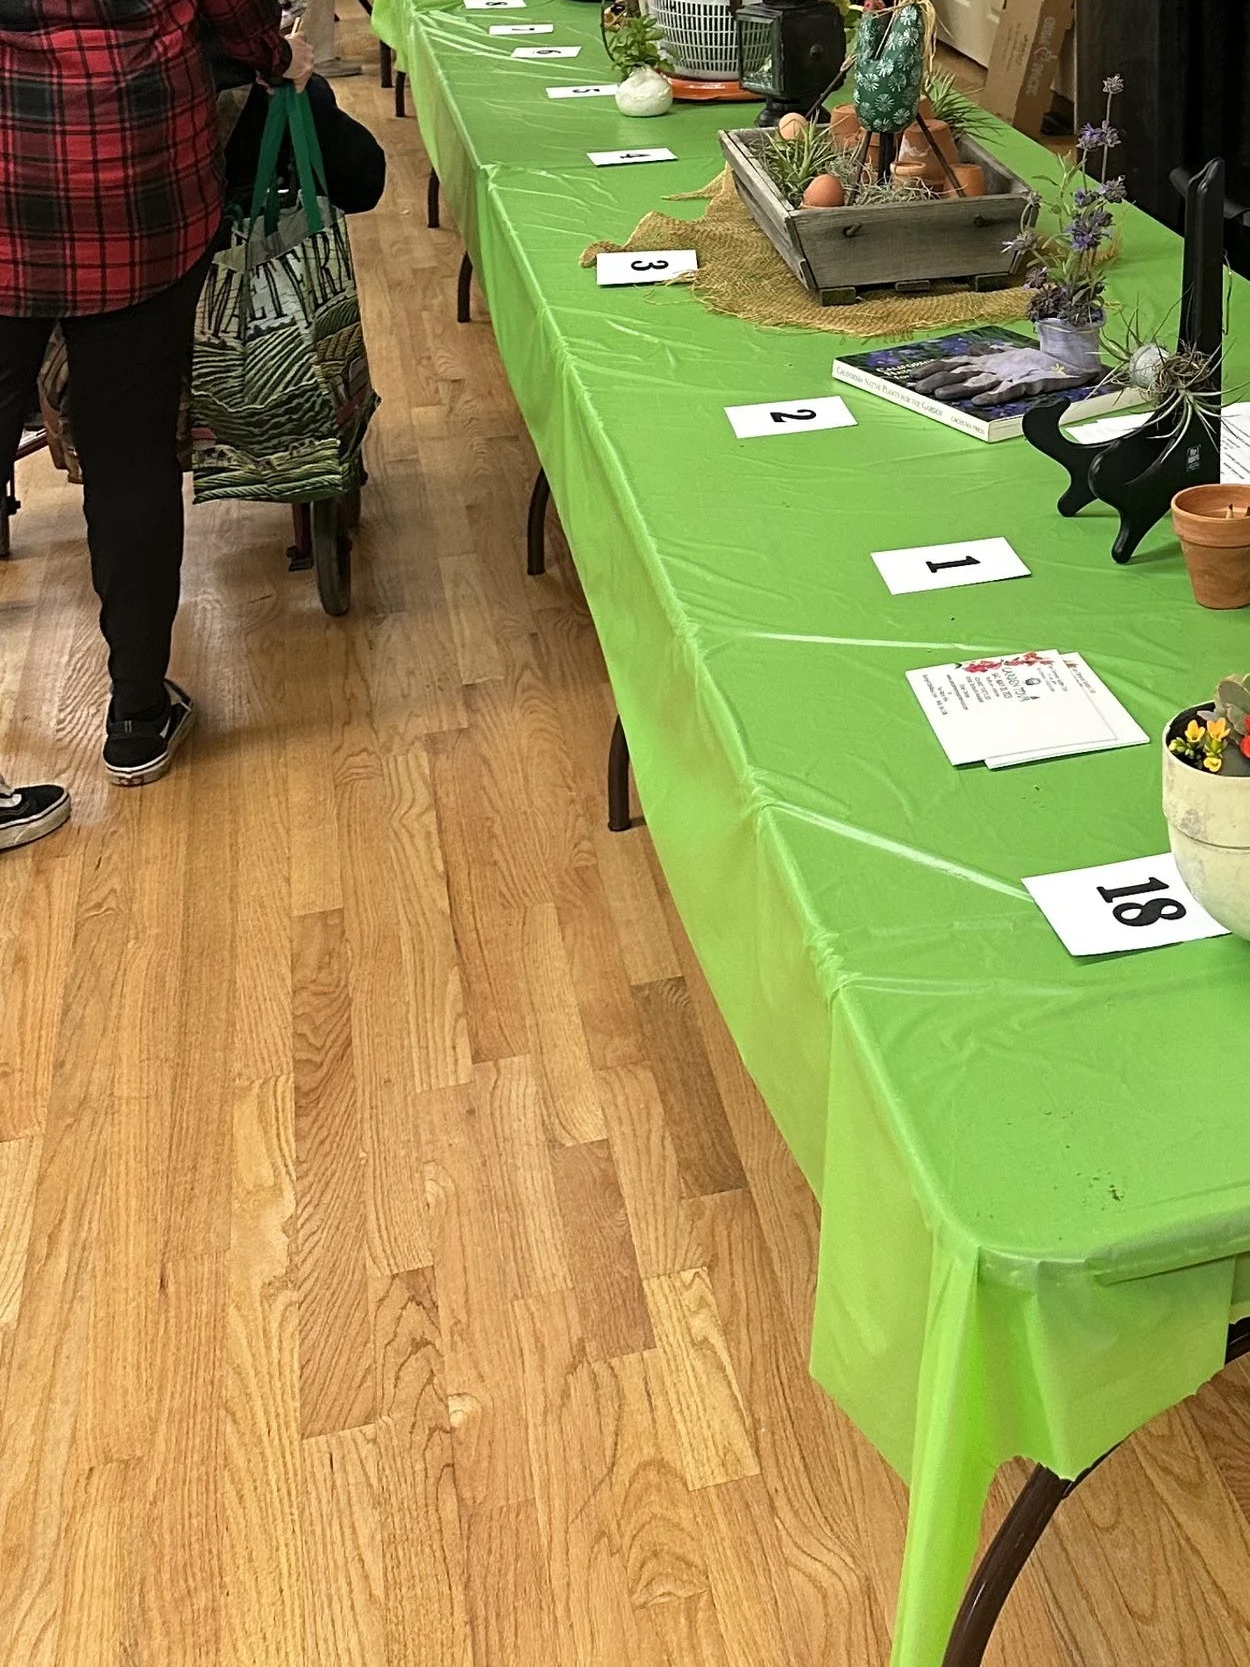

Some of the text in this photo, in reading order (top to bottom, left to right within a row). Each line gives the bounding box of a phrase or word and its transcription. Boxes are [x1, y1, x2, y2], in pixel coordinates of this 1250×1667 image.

[619, 152, 651, 160] 4
[630, 259, 669, 272] 3
[769, 409, 817, 423] 2
[925, 555, 981, 574] 1
[1096, 876, 1187, 927] 18
